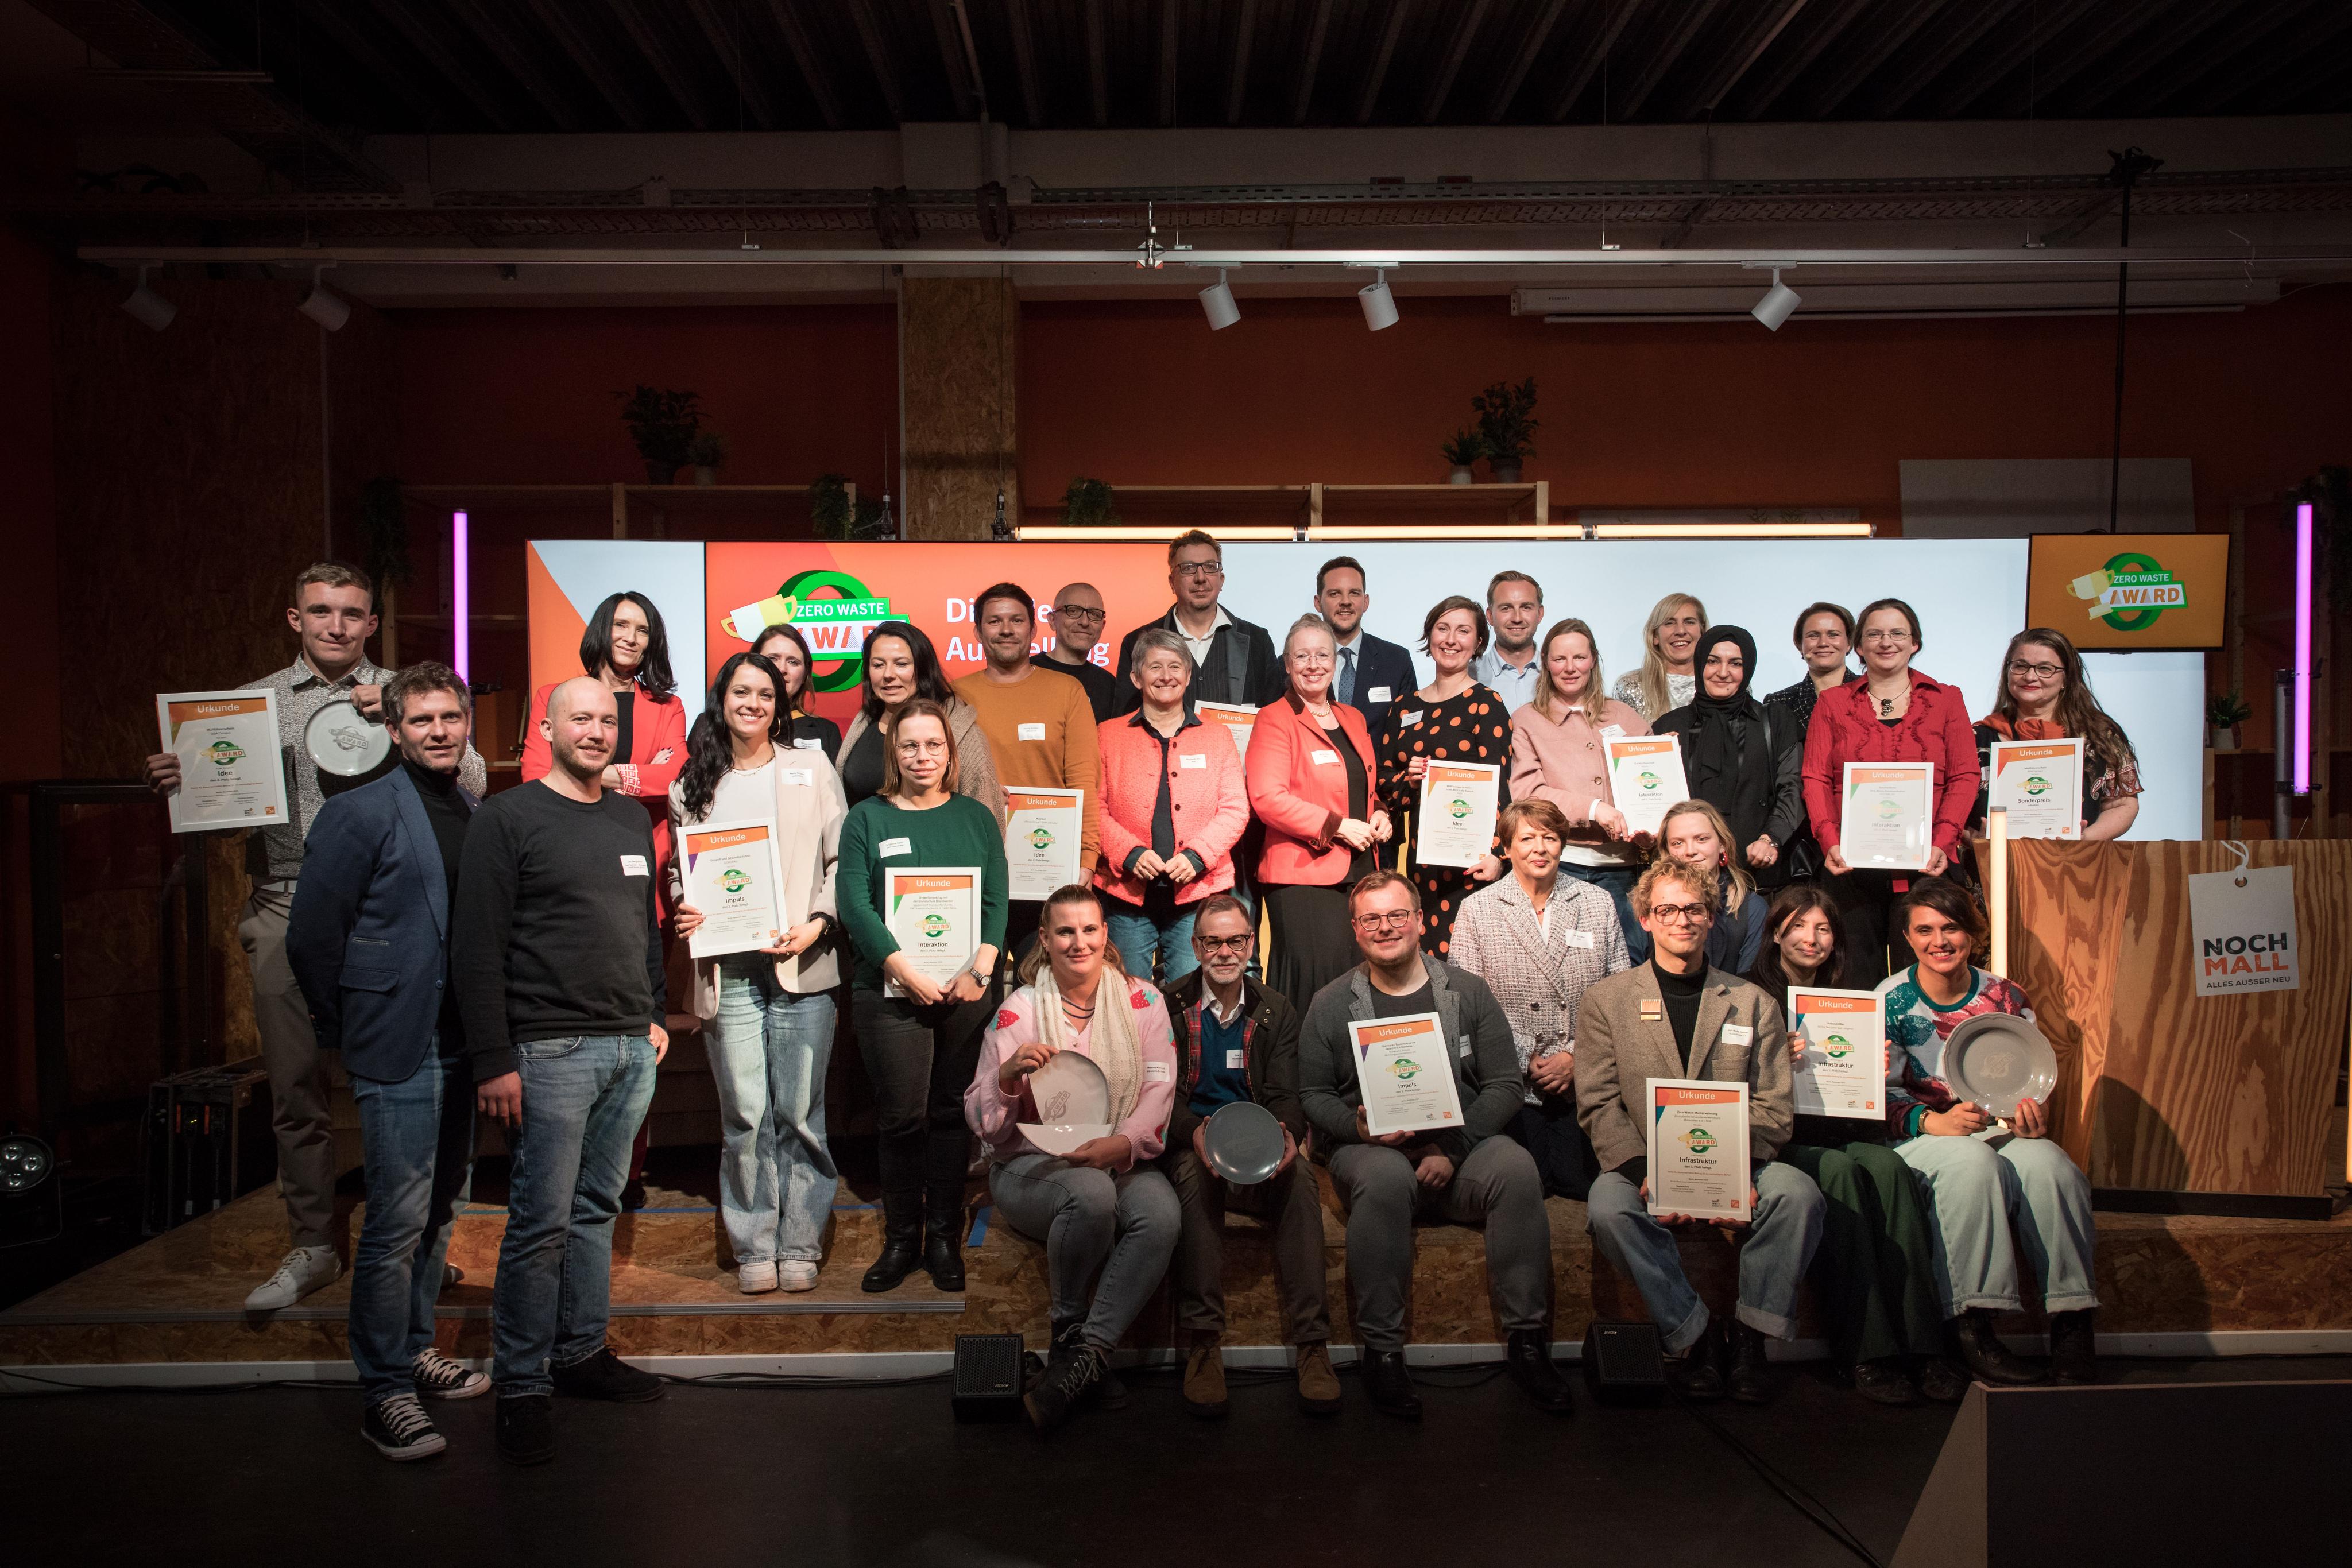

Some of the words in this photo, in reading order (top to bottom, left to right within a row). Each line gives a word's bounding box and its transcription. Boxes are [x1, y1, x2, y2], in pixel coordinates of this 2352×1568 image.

[2113, 574, 2137, 583] ZERO
[2139, 574, 2169, 583] WASTE
[2109, 587, 2180, 605] AWARD
[796, 604, 833, 617] ZERO
[837, 602, 885, 615] WASTE
[197, 704, 239, 713] Urkunde
[1217, 713, 1244, 722] Urkunde
[341, 737, 367, 746] AWARD
[216, 750, 243, 758] AWARD
[1447, 771, 1475, 779] Urkunde
[1027, 797, 1057, 806] Urkunde
[710, 833, 746, 844] Urkunde
[728, 877, 750, 885] AWARD
[916, 879, 951, 887] Urkunde
[2203, 932, 2288, 957] NOCH
[2204, 953, 2289, 976] MALL
[2206, 981, 2233, 989] ALLES
[2235, 978, 2270, 986] AUSSER
[1818, 1000, 1854, 1009] Urkunde
[1379, 1027, 1413, 1036] Urkunde
[1818, 1060, 1854, 1068] Infrastruktur
[1678, 1091, 1716, 1100] Urkunde
[1052, 1093, 1069, 1113] AWARD
